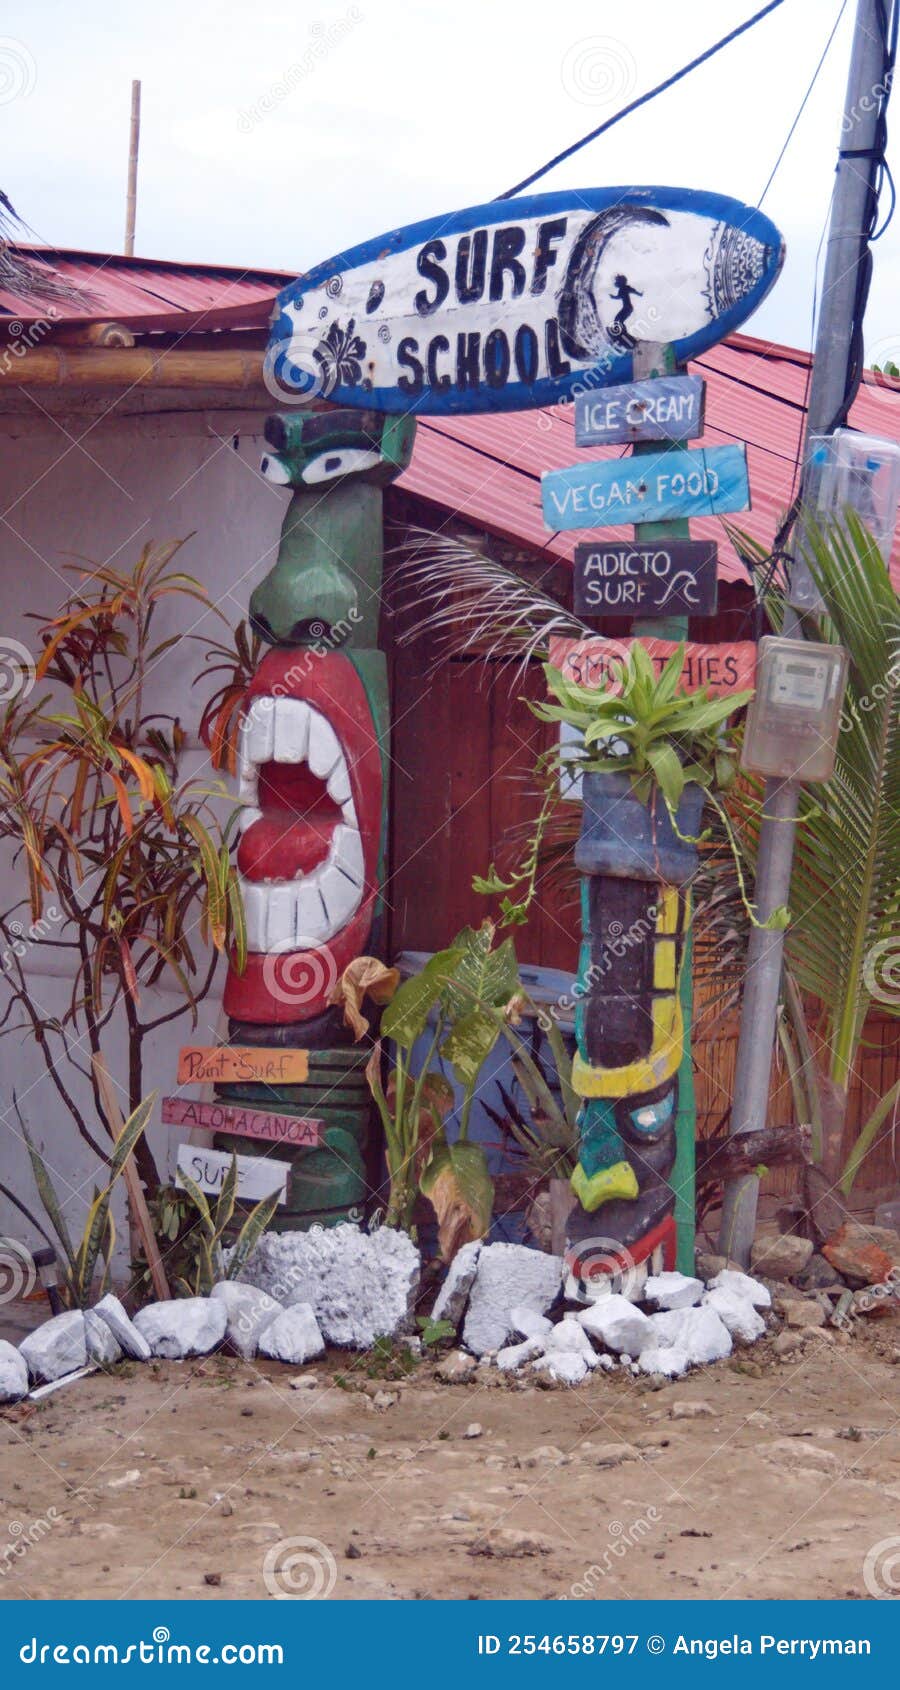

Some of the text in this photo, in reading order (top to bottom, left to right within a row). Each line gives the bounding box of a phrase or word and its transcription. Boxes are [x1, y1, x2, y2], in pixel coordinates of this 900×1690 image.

[414, 217, 568, 318] SURF
[397, 317, 571, 396] SCHOOL
[584, 393, 695, 433] ICE CREAM
[550, 468, 719, 515] VEGAN FOOD
[583, 552, 671, 577] ADICTO
[584, 580, 647, 605] SURF
[567, 653, 739, 687] SMOTHIES
